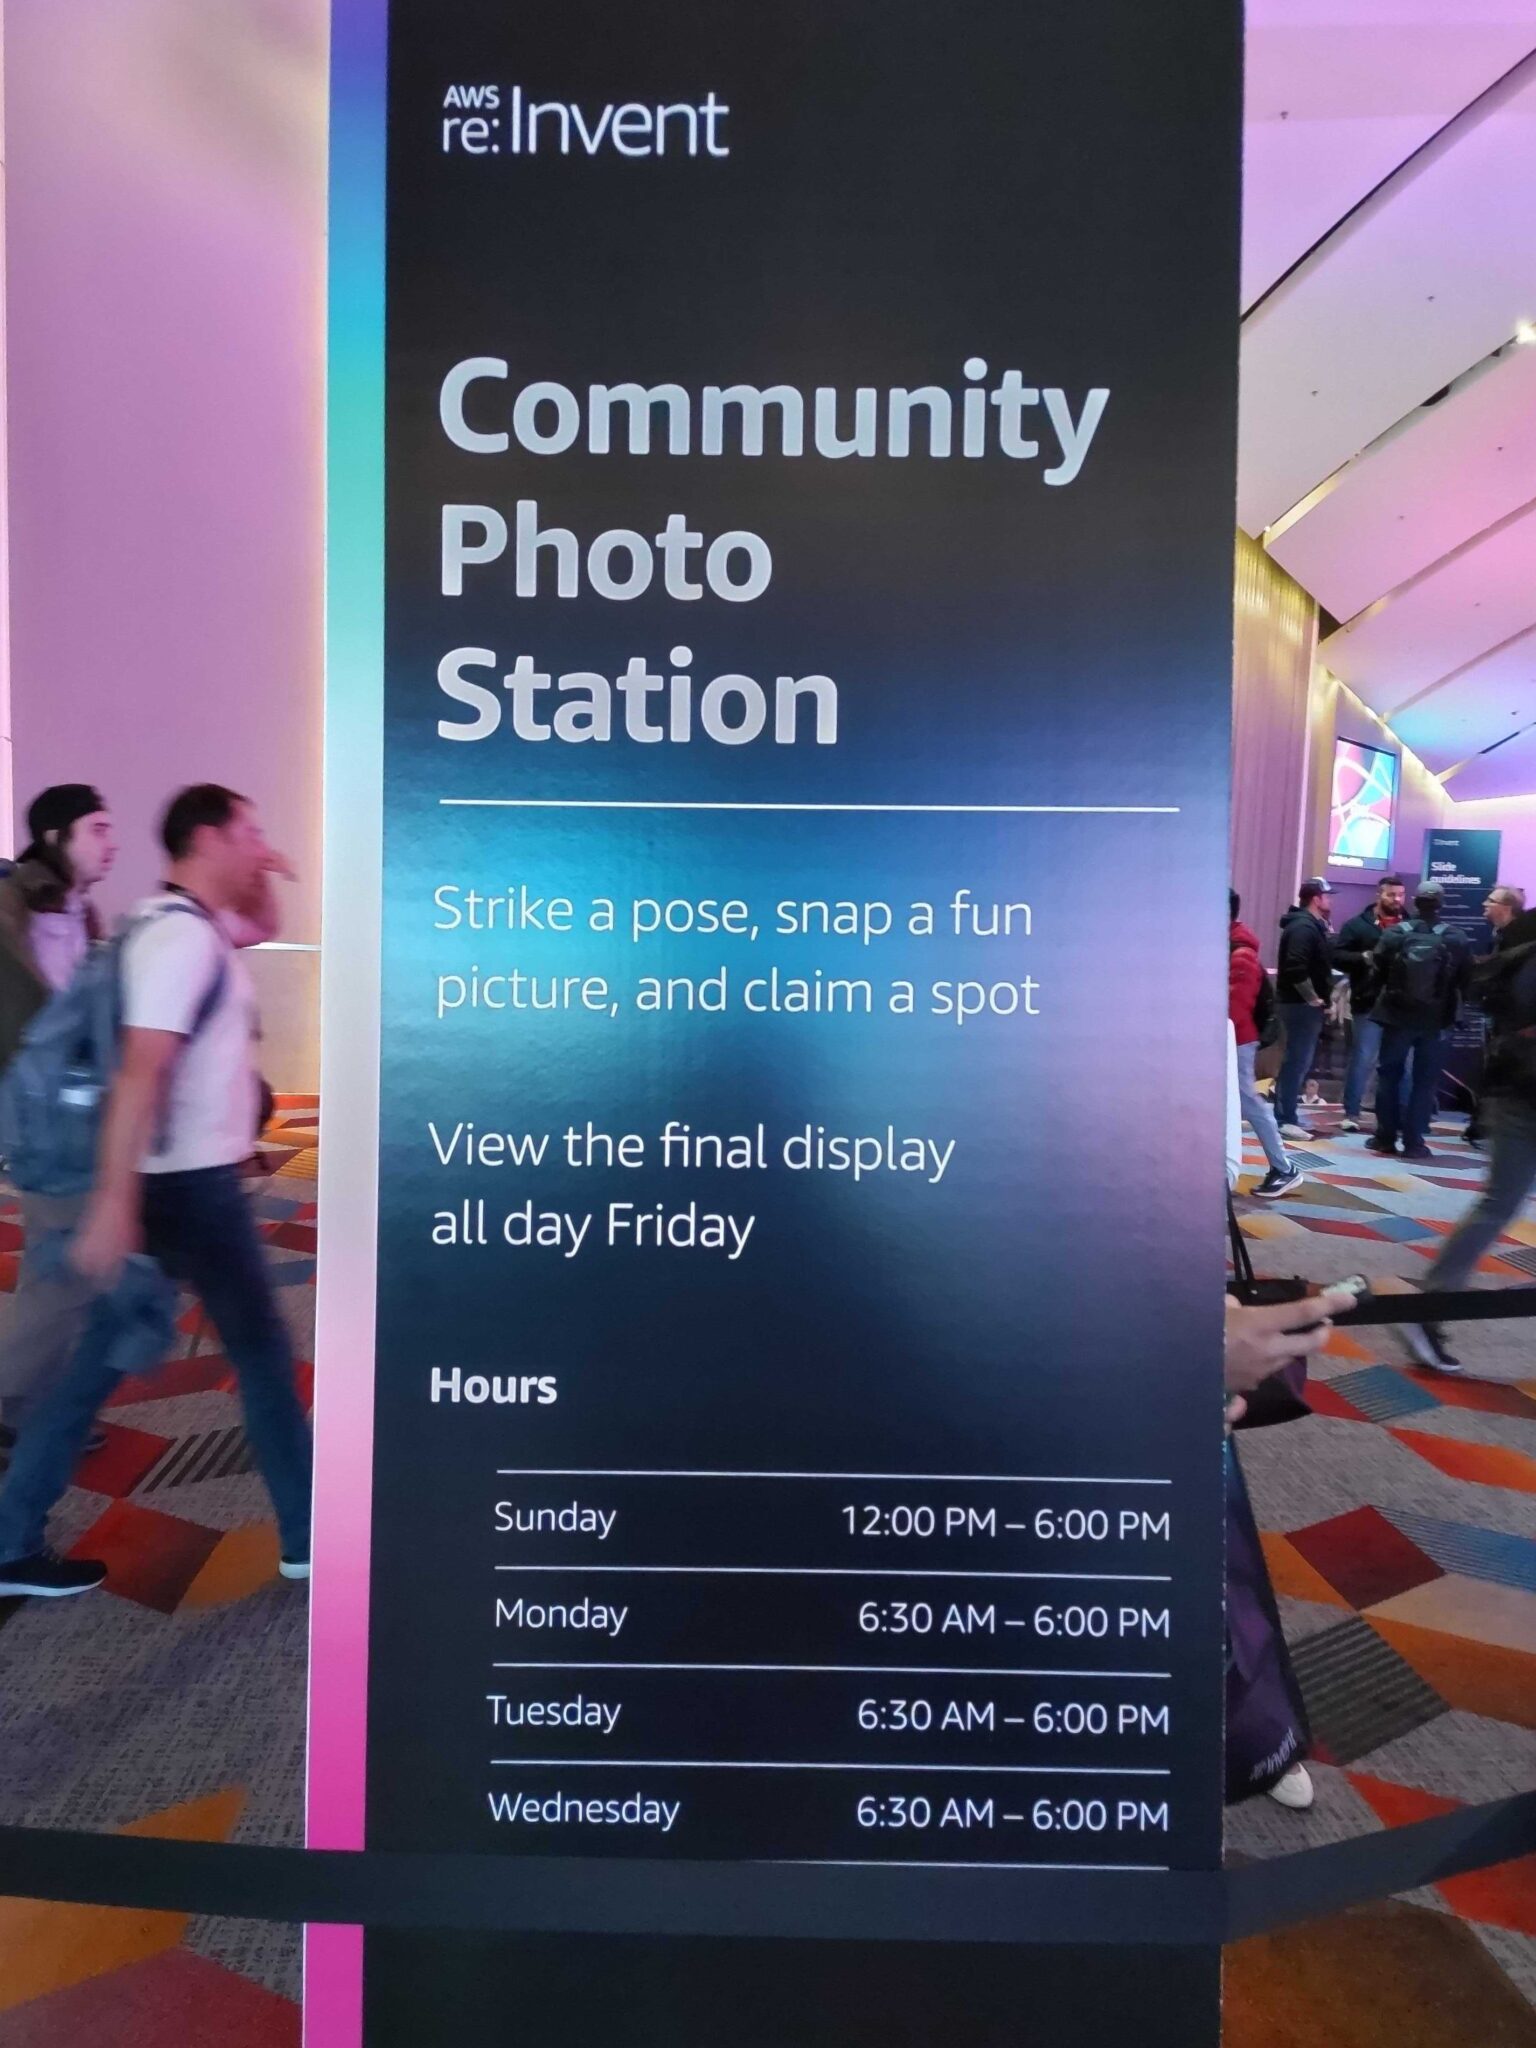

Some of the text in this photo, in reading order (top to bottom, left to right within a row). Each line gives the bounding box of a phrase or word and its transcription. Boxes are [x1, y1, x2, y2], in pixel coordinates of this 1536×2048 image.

[442, 84, 500, 110] AWS
[439, 356, 1111, 487] Community
[441, 499, 773, 603] Photo
[436, 645, 838, 746] Station
[434, 884, 1032, 946] Strike a pose, snap a fun
[437, 965, 1040, 1026] picture, and claim a spot
[427, 1121, 956, 1184] View the final display
[431, 1198, 756, 1260] all day Friday
[430, 1366, 558, 1405] Hours
[494, 1500, 617, 1540] Sunday
[842, 1505, 936, 1537] 12:00
[945, 1506, 996, 1538] PM
[1034, 1508, 1109, 1541] 6:00
[1119, 1510, 1170, 1541] PM
[495, 1596, 629, 1637] Monday
[859, 1601, 933, 1634] 6:30
[941, 1603, 995, 1634] AM
[1033, 1604, 1109, 1638] 6:00
[1119, 1607, 1170, 1639] PM
[485, 1693, 622, 1734] Tuesday
[858, 1698, 932, 1731] 6:30
[940, 1700, 995, 1732] AM
[1033, 1702, 1108, 1735] 6:00
[1118, 1704, 1169, 1735] PM
[487, 1790, 681, 1832] Wednesday
[857, 1795, 931, 1828] 6:30
[939, 1797, 994, 1829] AM
[1032, 1798, 1107, 1832] 6:00
[1117, 1800, 1169, 1832] PM
